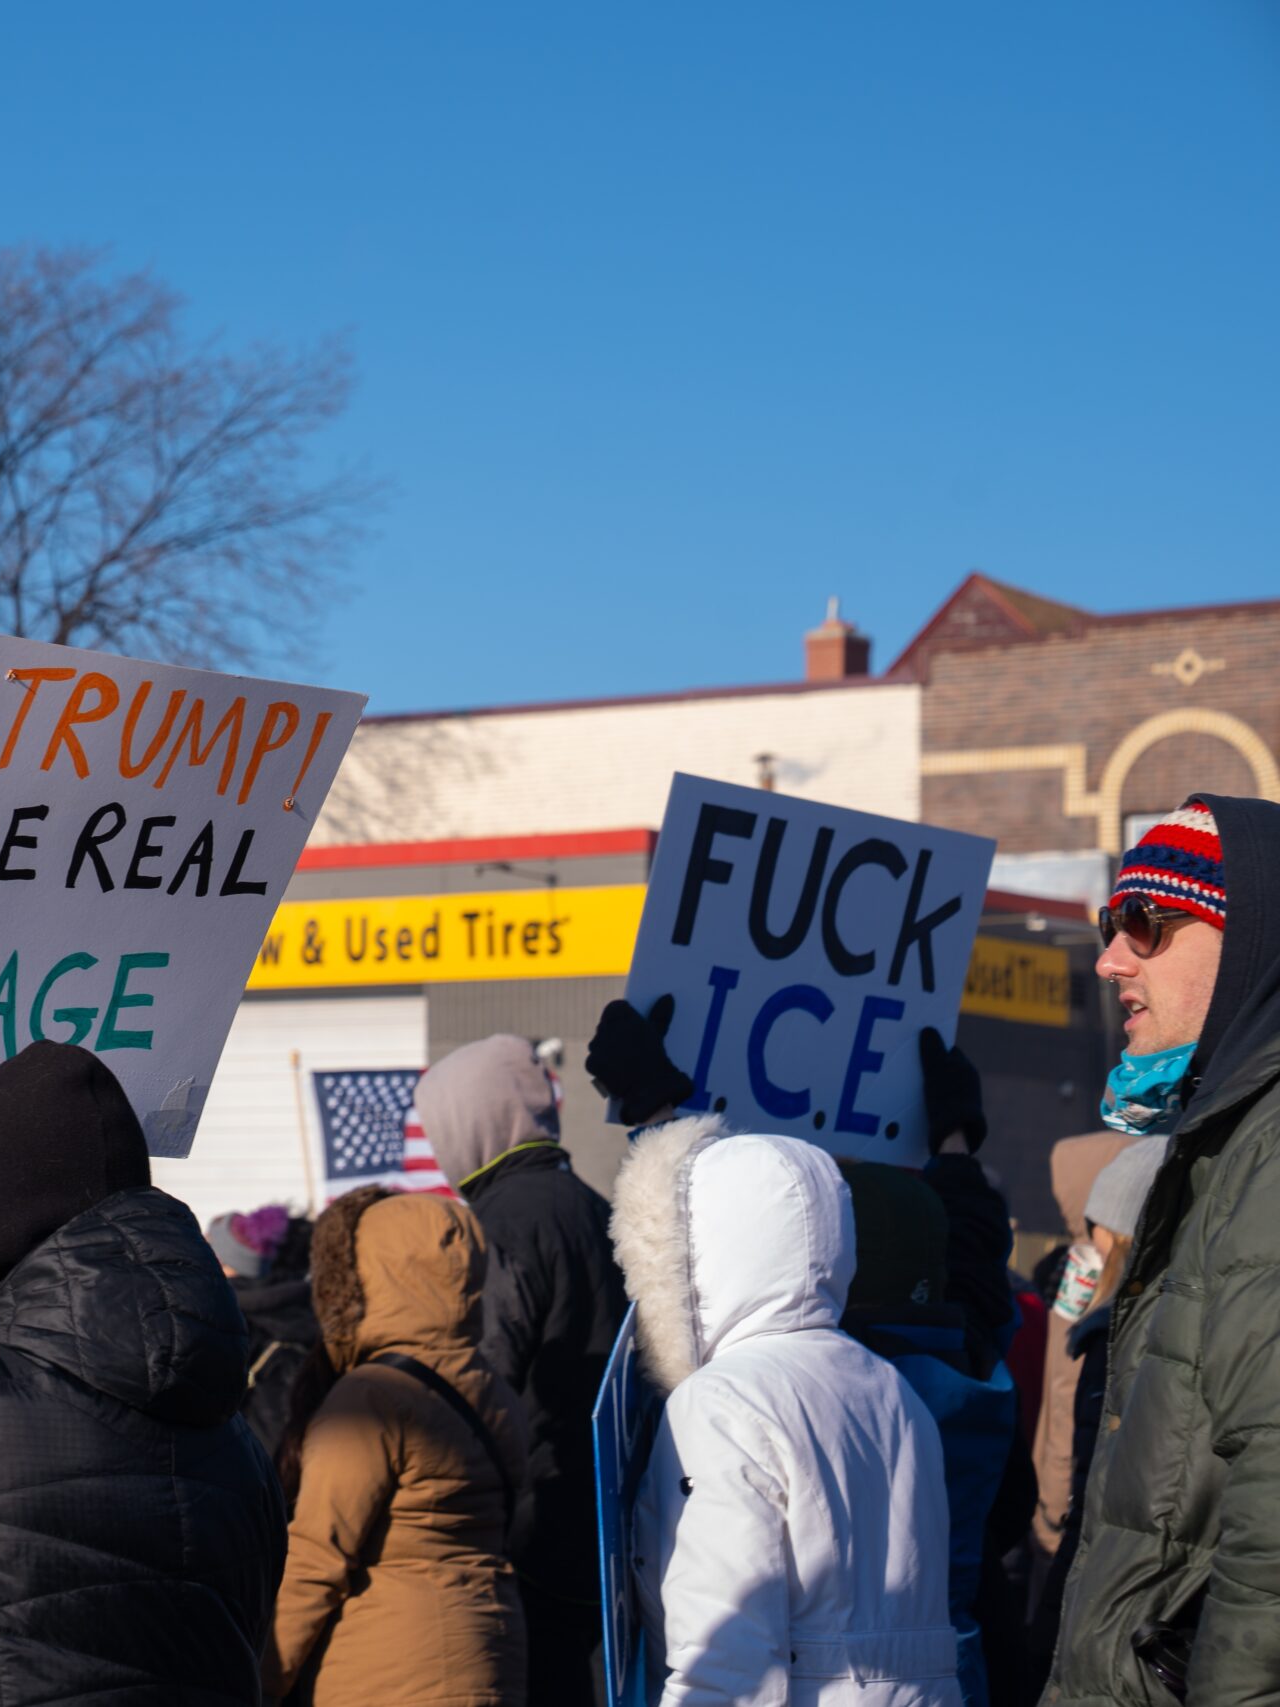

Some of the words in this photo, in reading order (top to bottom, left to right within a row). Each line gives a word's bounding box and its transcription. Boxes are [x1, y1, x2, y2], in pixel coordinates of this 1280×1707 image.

[65, 802, 268, 897] REAL
[671, 802, 963, 994] FUCK
[301, 919, 326, 967] &
[345, 907, 441, 964] Used
[463, 909, 564, 957] Tires
[677, 965, 901, 1140] I.C.E.
